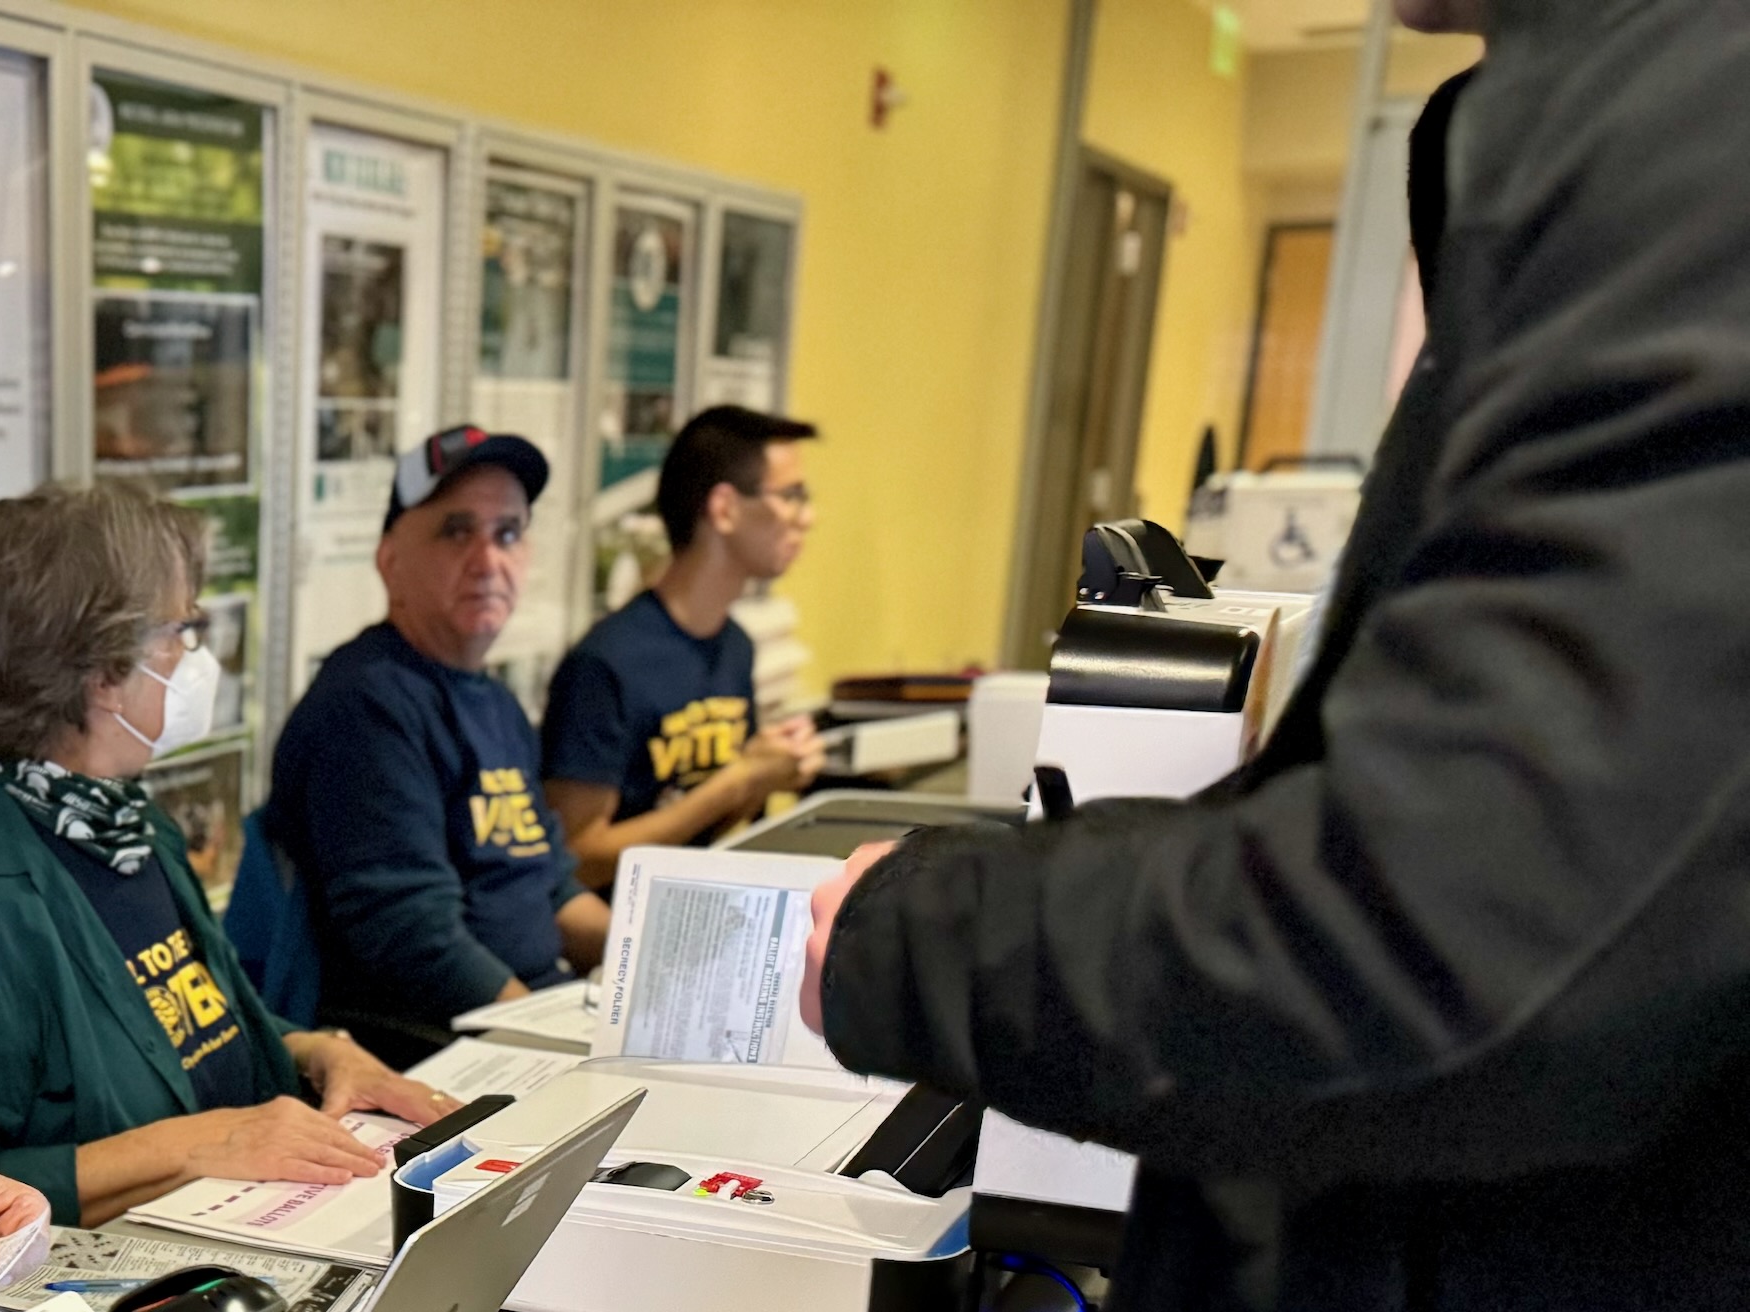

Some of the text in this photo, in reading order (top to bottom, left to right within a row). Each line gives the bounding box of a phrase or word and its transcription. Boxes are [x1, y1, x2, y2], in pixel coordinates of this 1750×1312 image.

[617, 936, 632, 983] SECRECY
[609, 984, 625, 1026] FOLDER
[246, 1199, 306, 1227] BALLOTS
